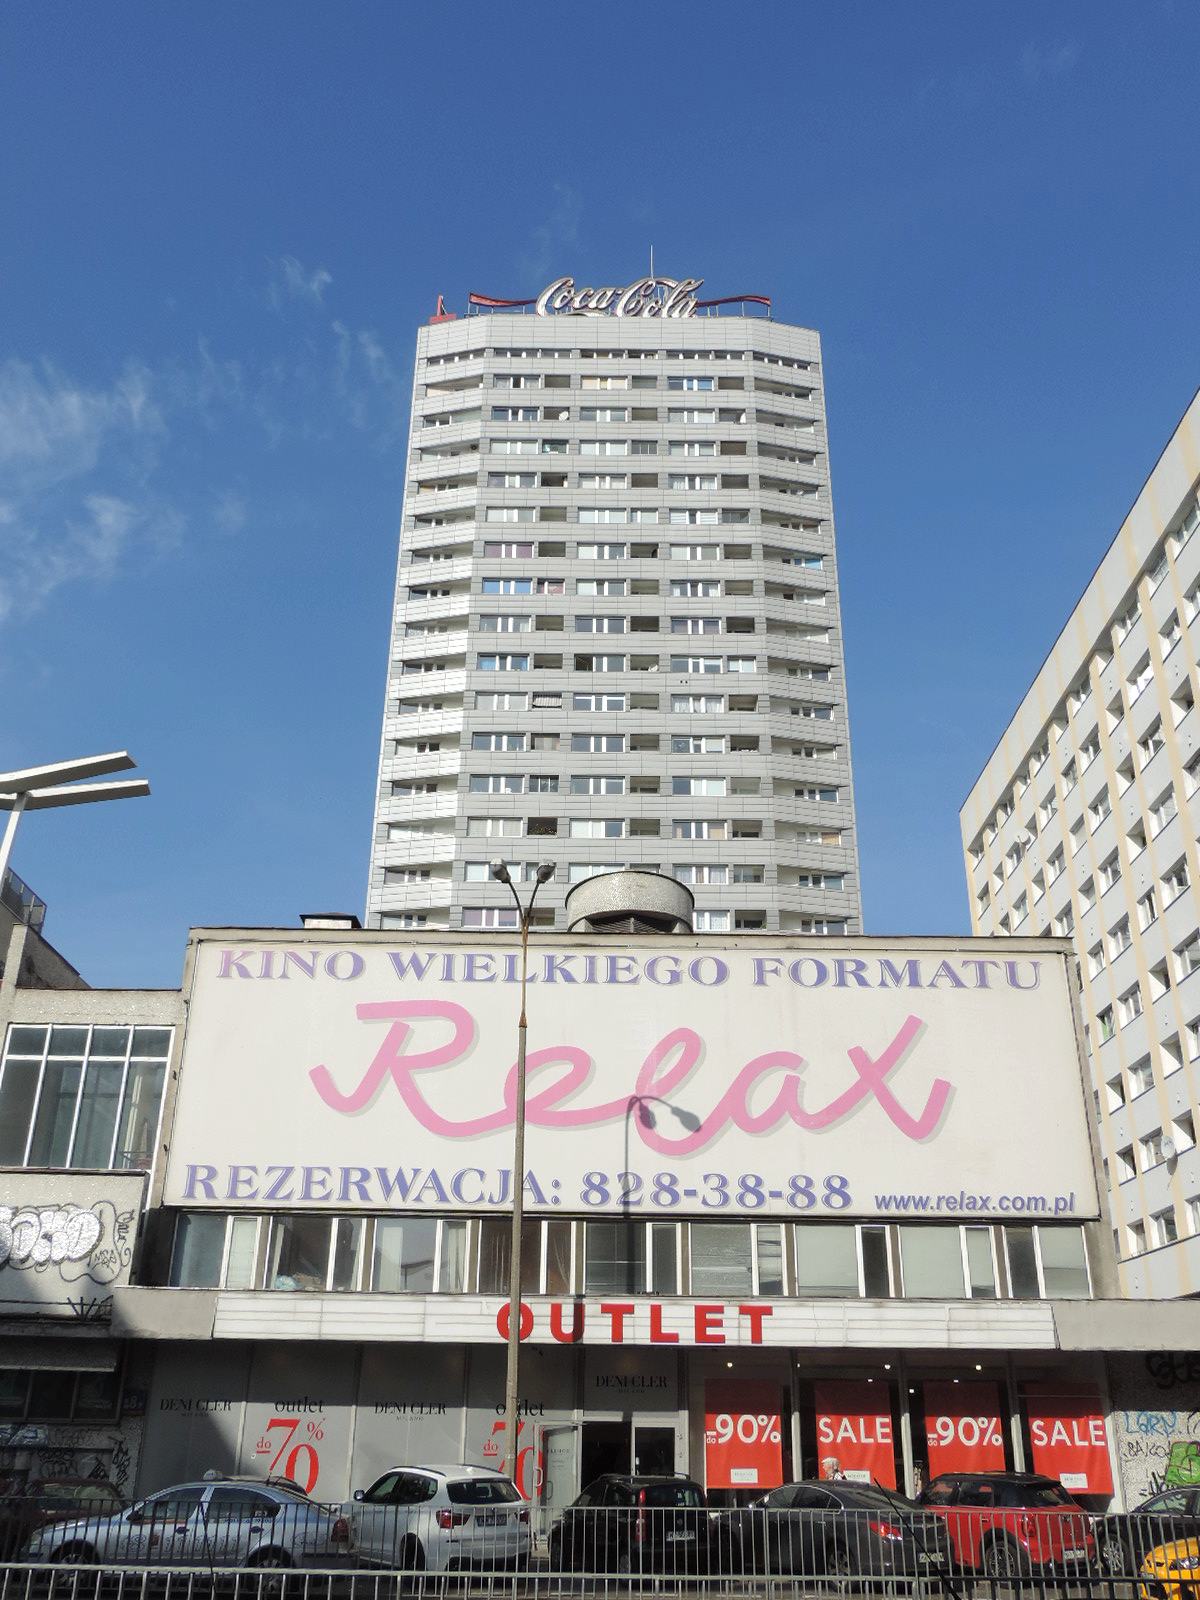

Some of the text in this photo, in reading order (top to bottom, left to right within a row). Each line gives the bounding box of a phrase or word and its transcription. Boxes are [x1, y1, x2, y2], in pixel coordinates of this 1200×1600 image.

[536, 276, 704, 317] Coca-Cola
[217, 950, 1041, 990] KINO WIELKIEGO FORMATU
[309, 999, 952, 1157] Relax
[182, 1164, 853, 1211] REZERWACJA: 828-38-88
[875, 1192, 1076, 1217] www.relax.com.pl
[496, 1303, 773, 1345] OUTLET
[274, 1396, 324, 1413] outlet
[495, 1399, 545, 1416] otlet
[818, 1416, 892, 1444] SALE
[1031, 1419, 1106, 1447] SALE
